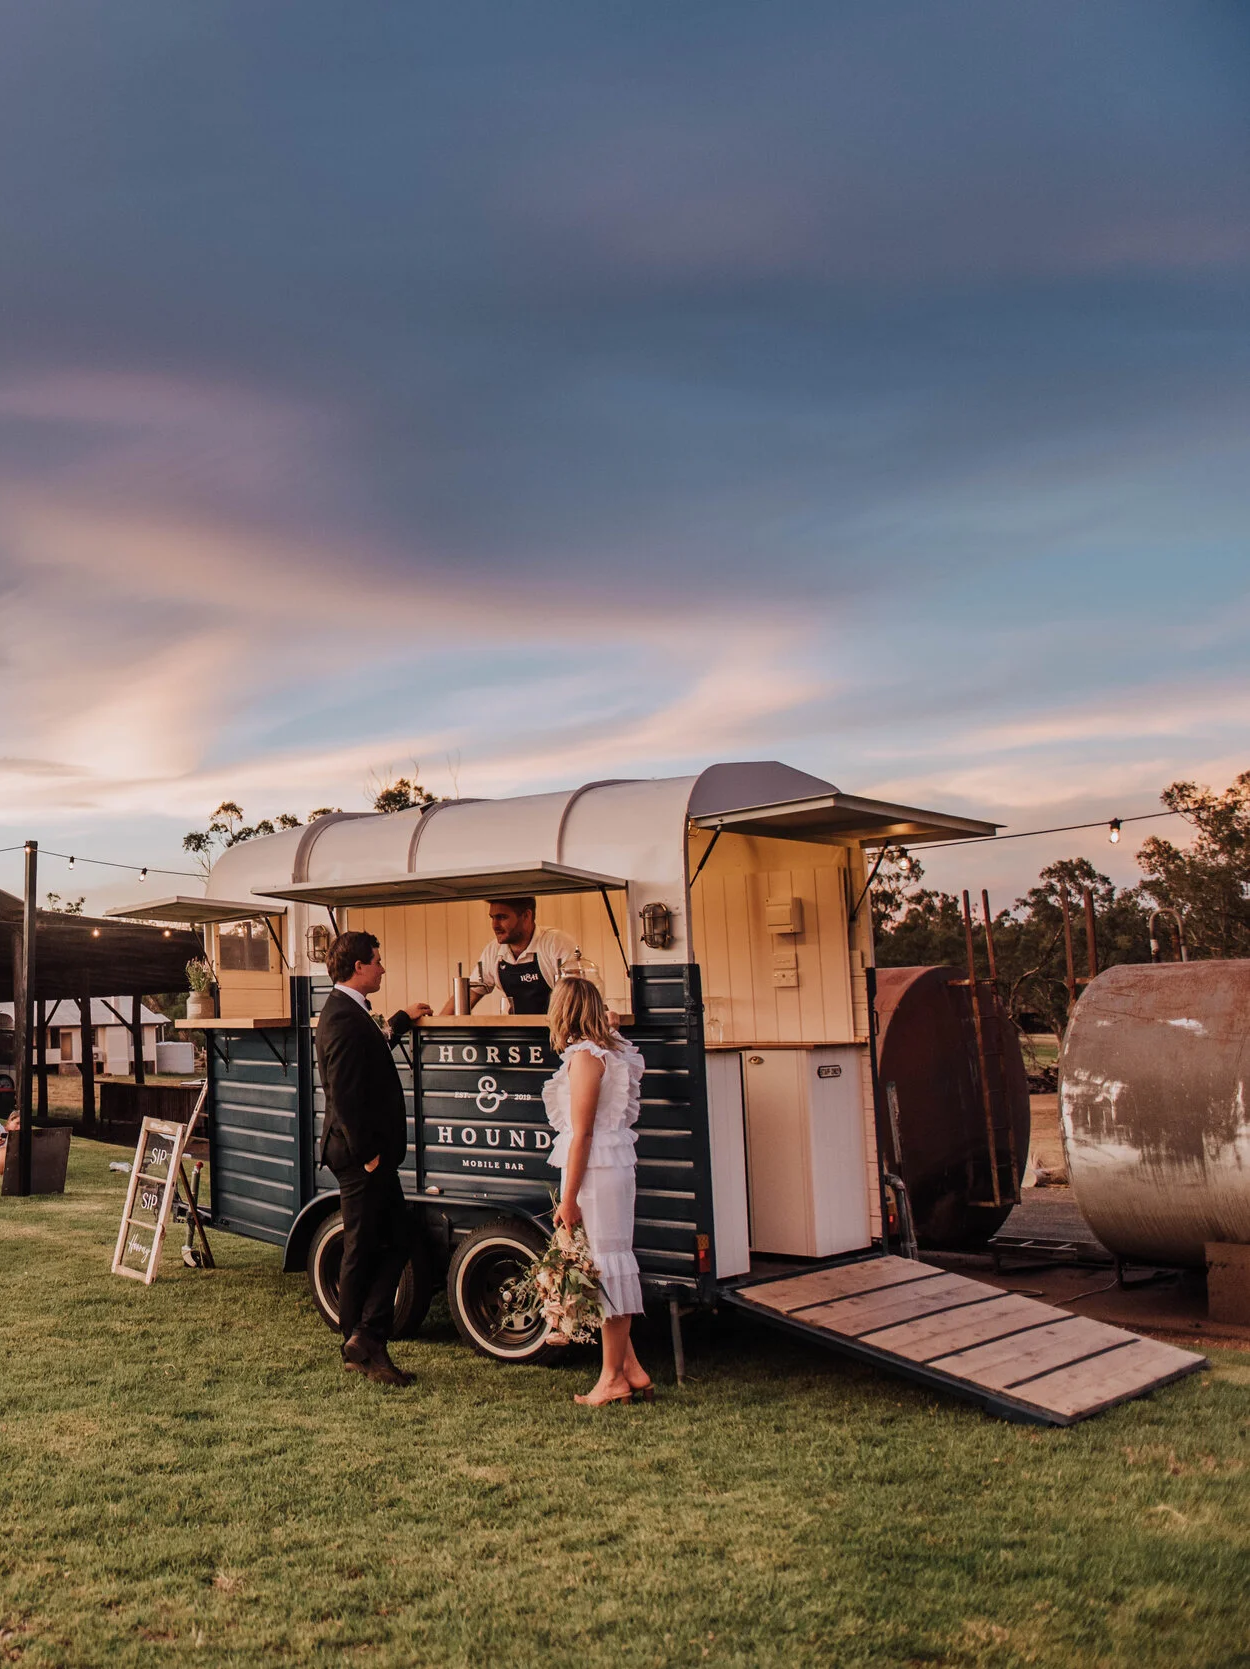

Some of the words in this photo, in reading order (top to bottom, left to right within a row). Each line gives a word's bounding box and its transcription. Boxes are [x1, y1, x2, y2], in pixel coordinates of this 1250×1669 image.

[438, 1045, 544, 1064] HORSE
[476, 1076, 509, 1113] &
[514, 1093, 532, 1101] 2019
[438, 1126, 551, 1149] HOUND
[150, 1147, 167, 1166] SIP
[462, 1159, 500, 1169] MOBILE
[504, 1162, 524, 1171] BAR
[141, 1192, 158, 1210] SIP
